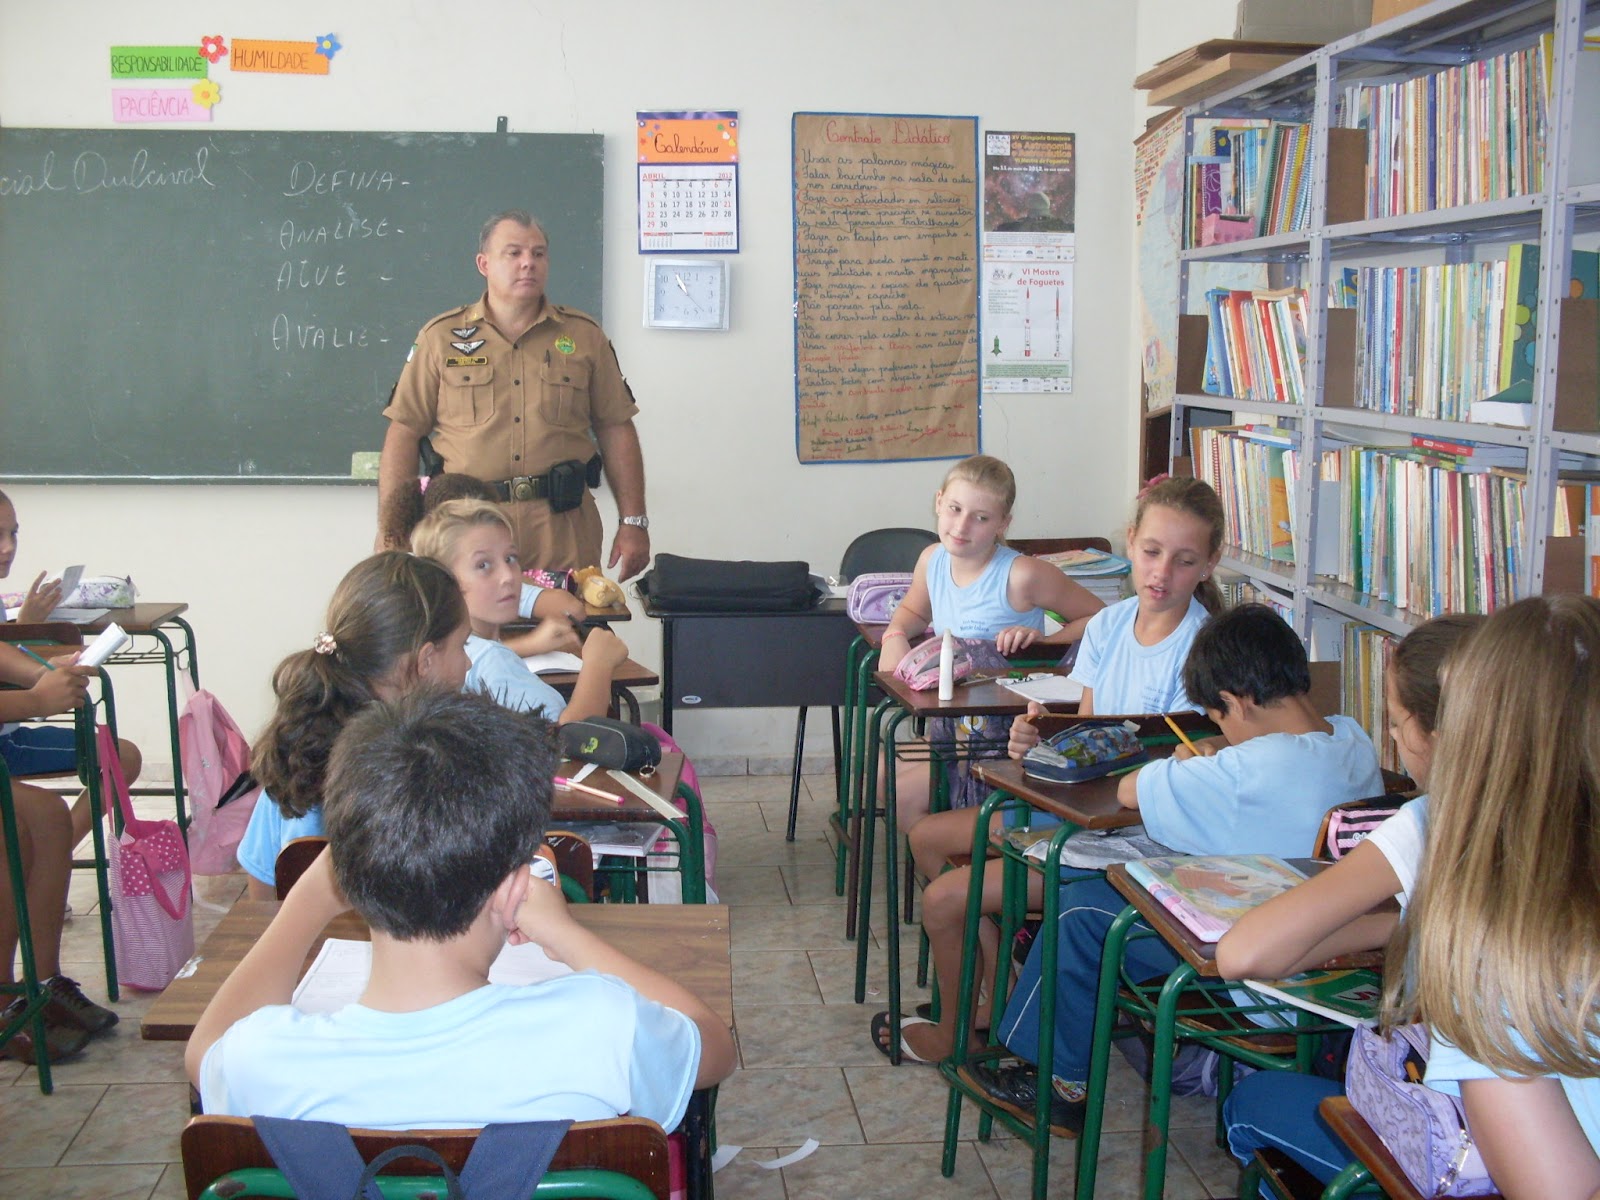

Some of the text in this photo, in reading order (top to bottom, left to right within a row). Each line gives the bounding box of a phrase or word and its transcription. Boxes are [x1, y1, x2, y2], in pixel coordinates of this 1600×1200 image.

[111, 55, 202, 74] RESPONSABILIDADE
[234, 48, 310, 70] HUMILDADE
[119, 90, 189, 116] PACIÊNCIA
[826, 119, 951, 144] Contrato Didático
[654, 133, 719, 153] Calendário
[802, 148, 831, 164] Usar
[1022, 268, 1060, 276] VI Mostra
[1017, 278, 1065, 287] de Foguetes
